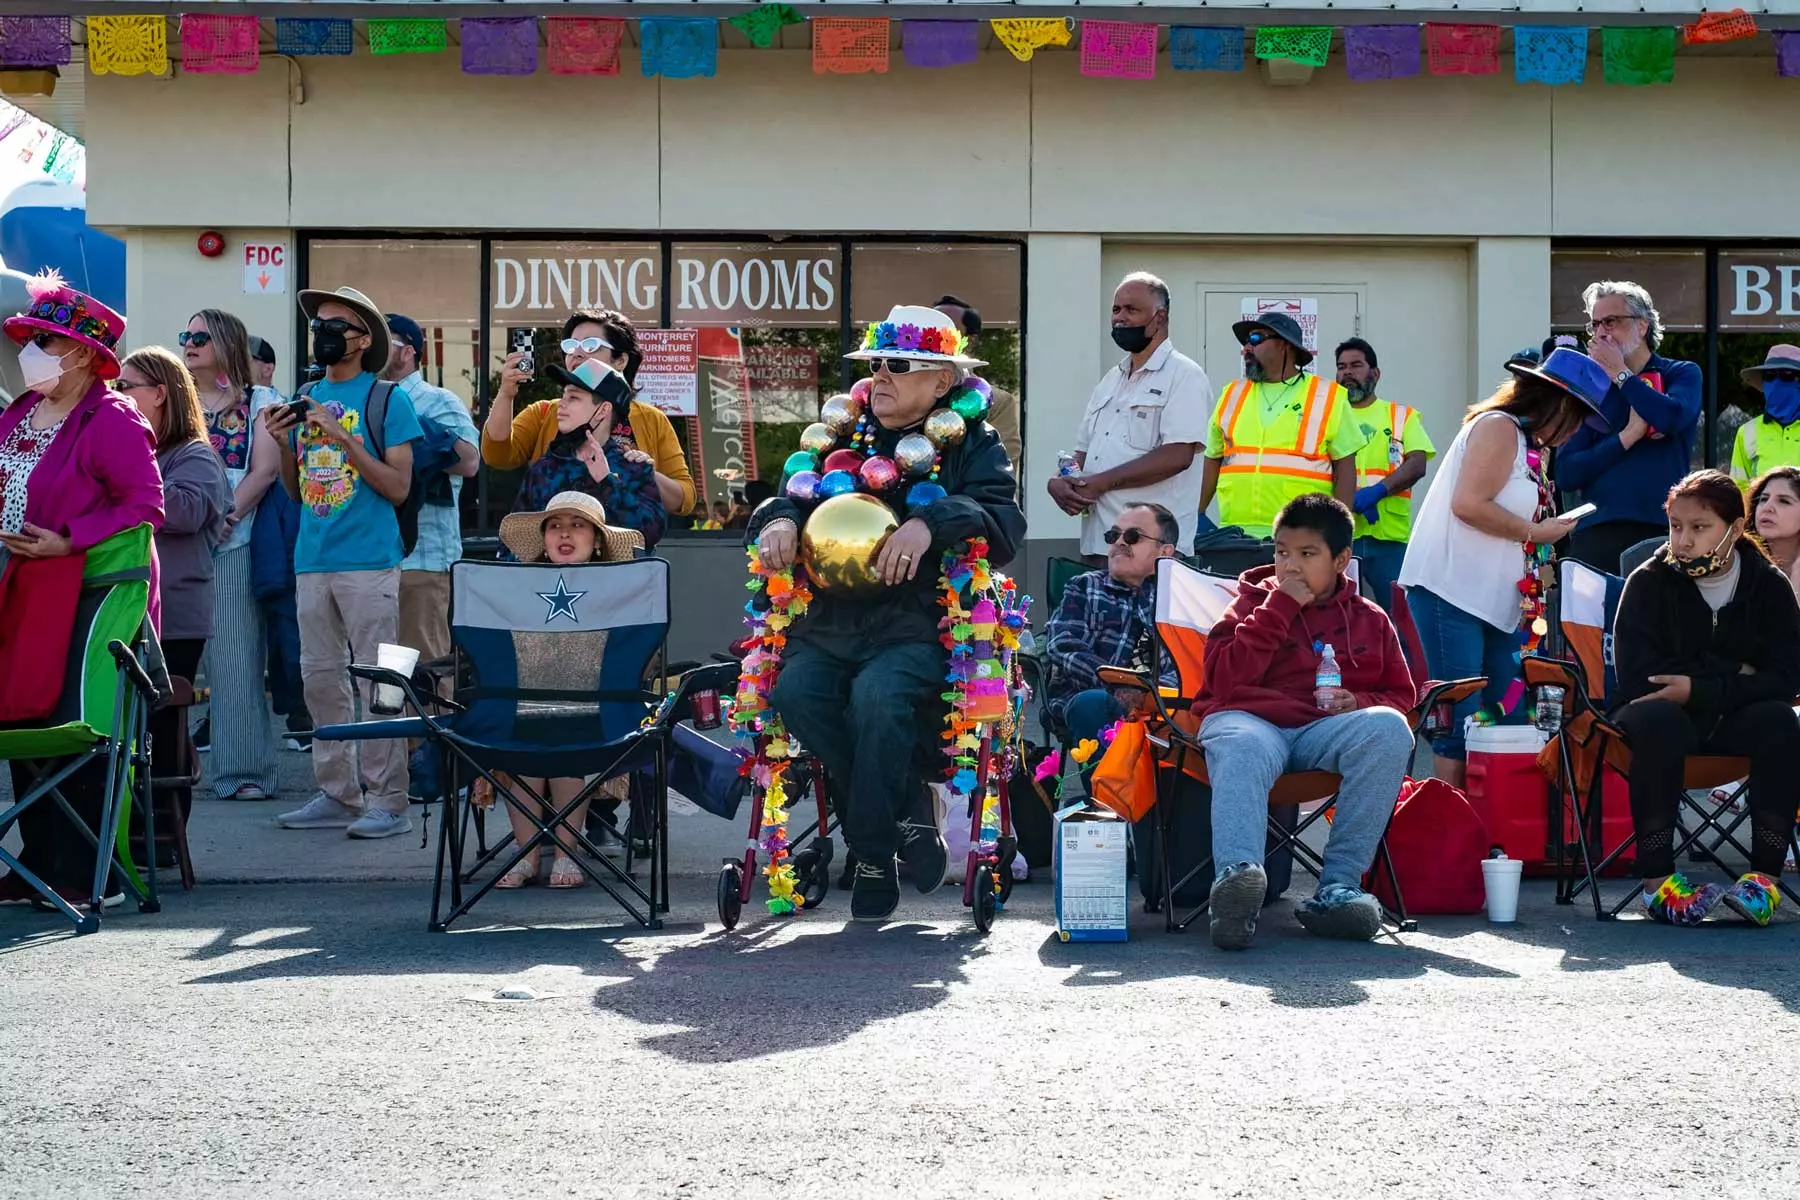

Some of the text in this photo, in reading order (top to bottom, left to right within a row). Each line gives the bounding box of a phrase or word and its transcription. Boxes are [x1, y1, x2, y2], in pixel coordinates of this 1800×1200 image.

[245, 246, 284, 267] FDC
[494, 258, 835, 311] DINING ROOMS
[636, 332, 696, 341] MONTERREY
[639, 343, 692, 352] FURNITURE
